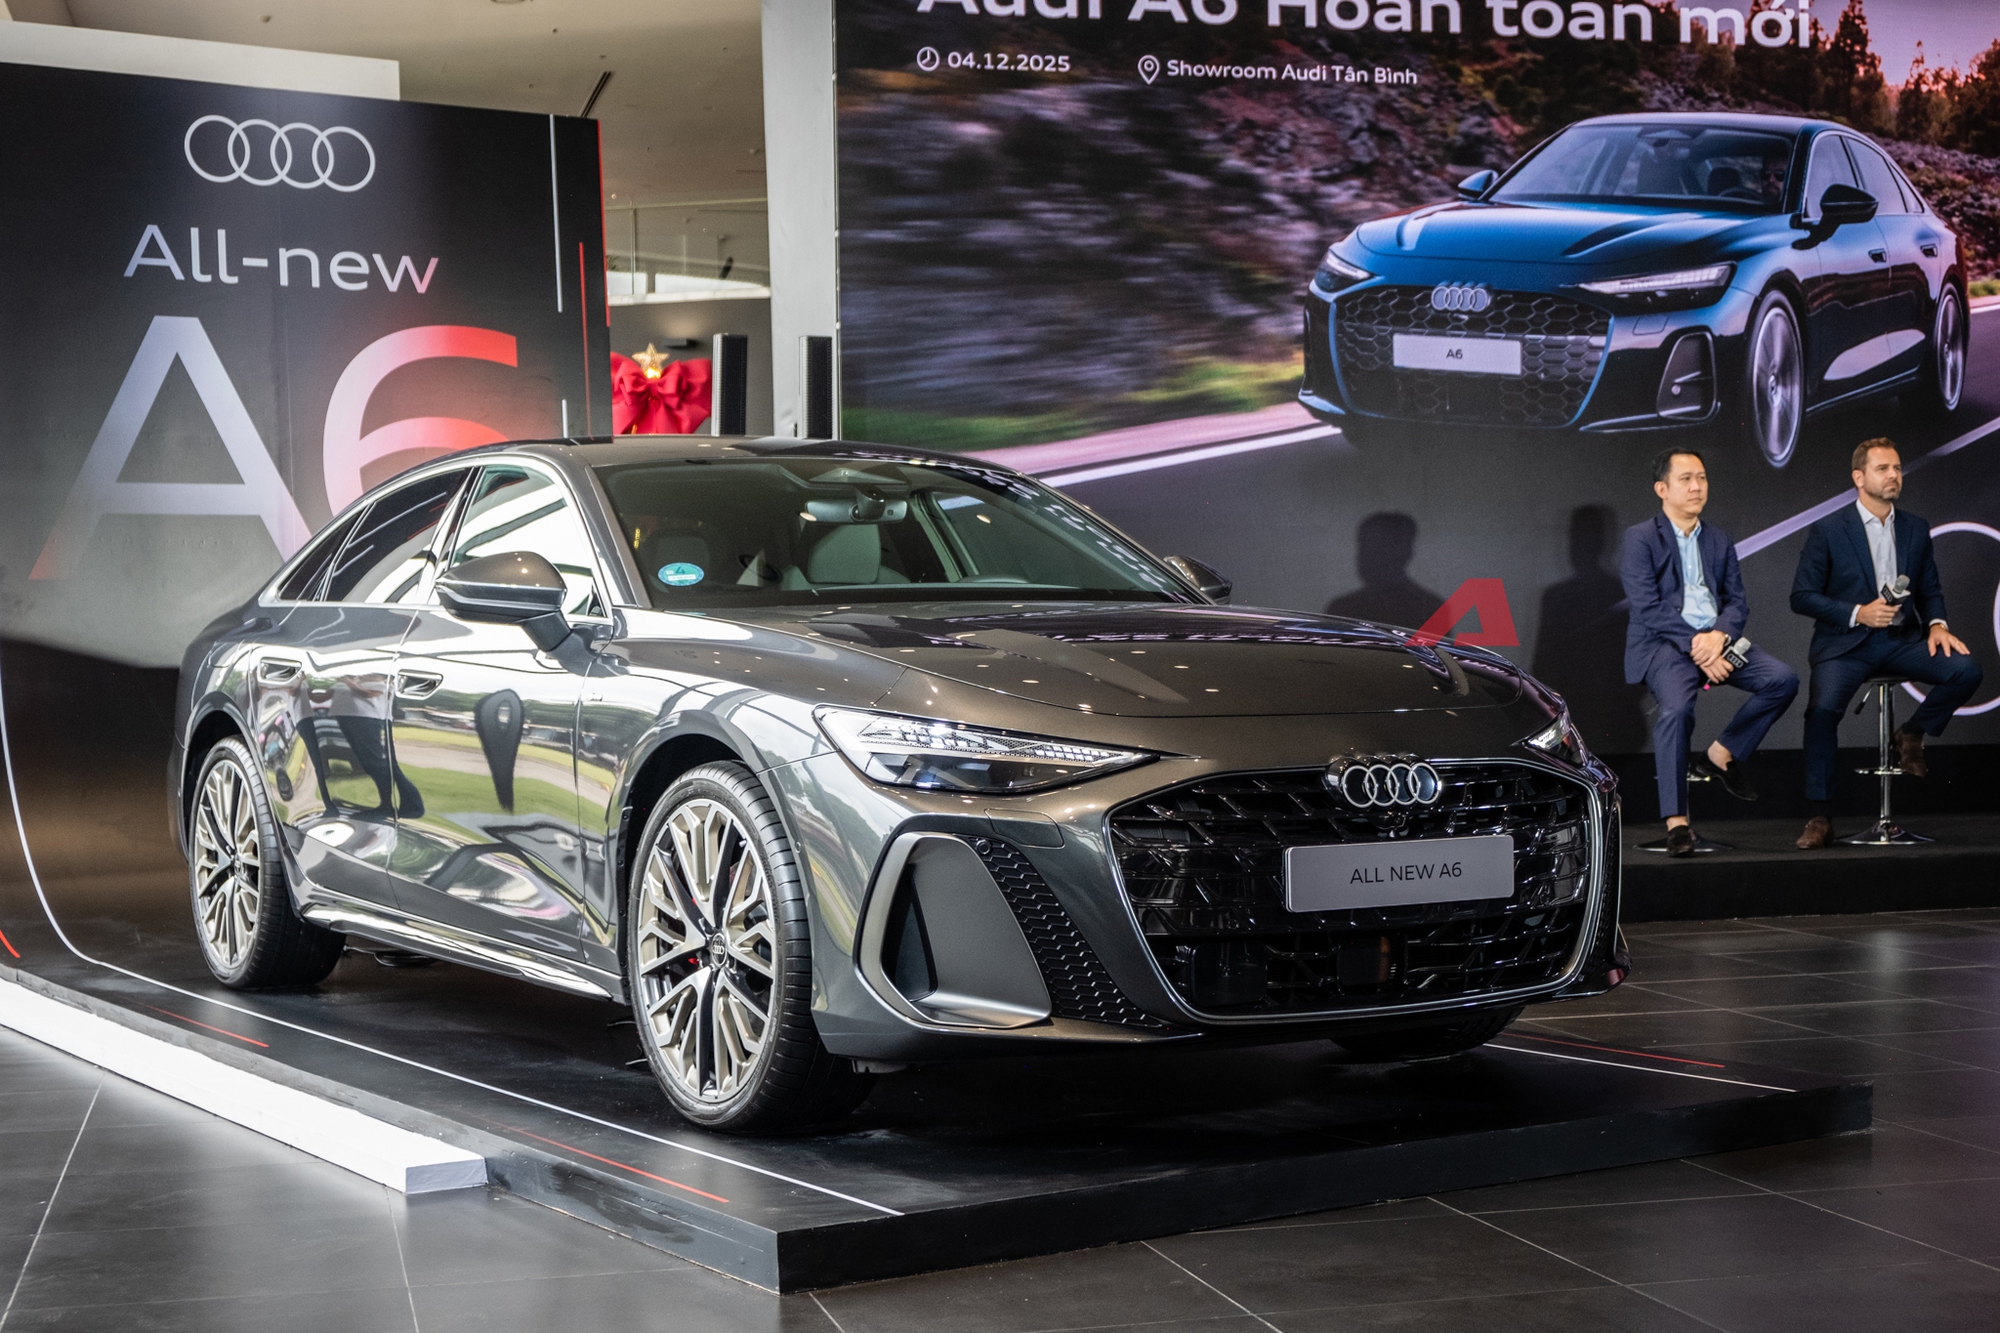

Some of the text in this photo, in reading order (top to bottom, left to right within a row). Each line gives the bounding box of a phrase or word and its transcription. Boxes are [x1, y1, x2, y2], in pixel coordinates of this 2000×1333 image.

[947, 51, 1071, 73] 04.12.2025
[1167, 59, 1418, 85] Showroom Audi Tân Bình
[124, 224, 439, 294] All-new
[1445, 348, 1464, 360] A6
[1350, 861, 1462, 884] ALL NEW A6
